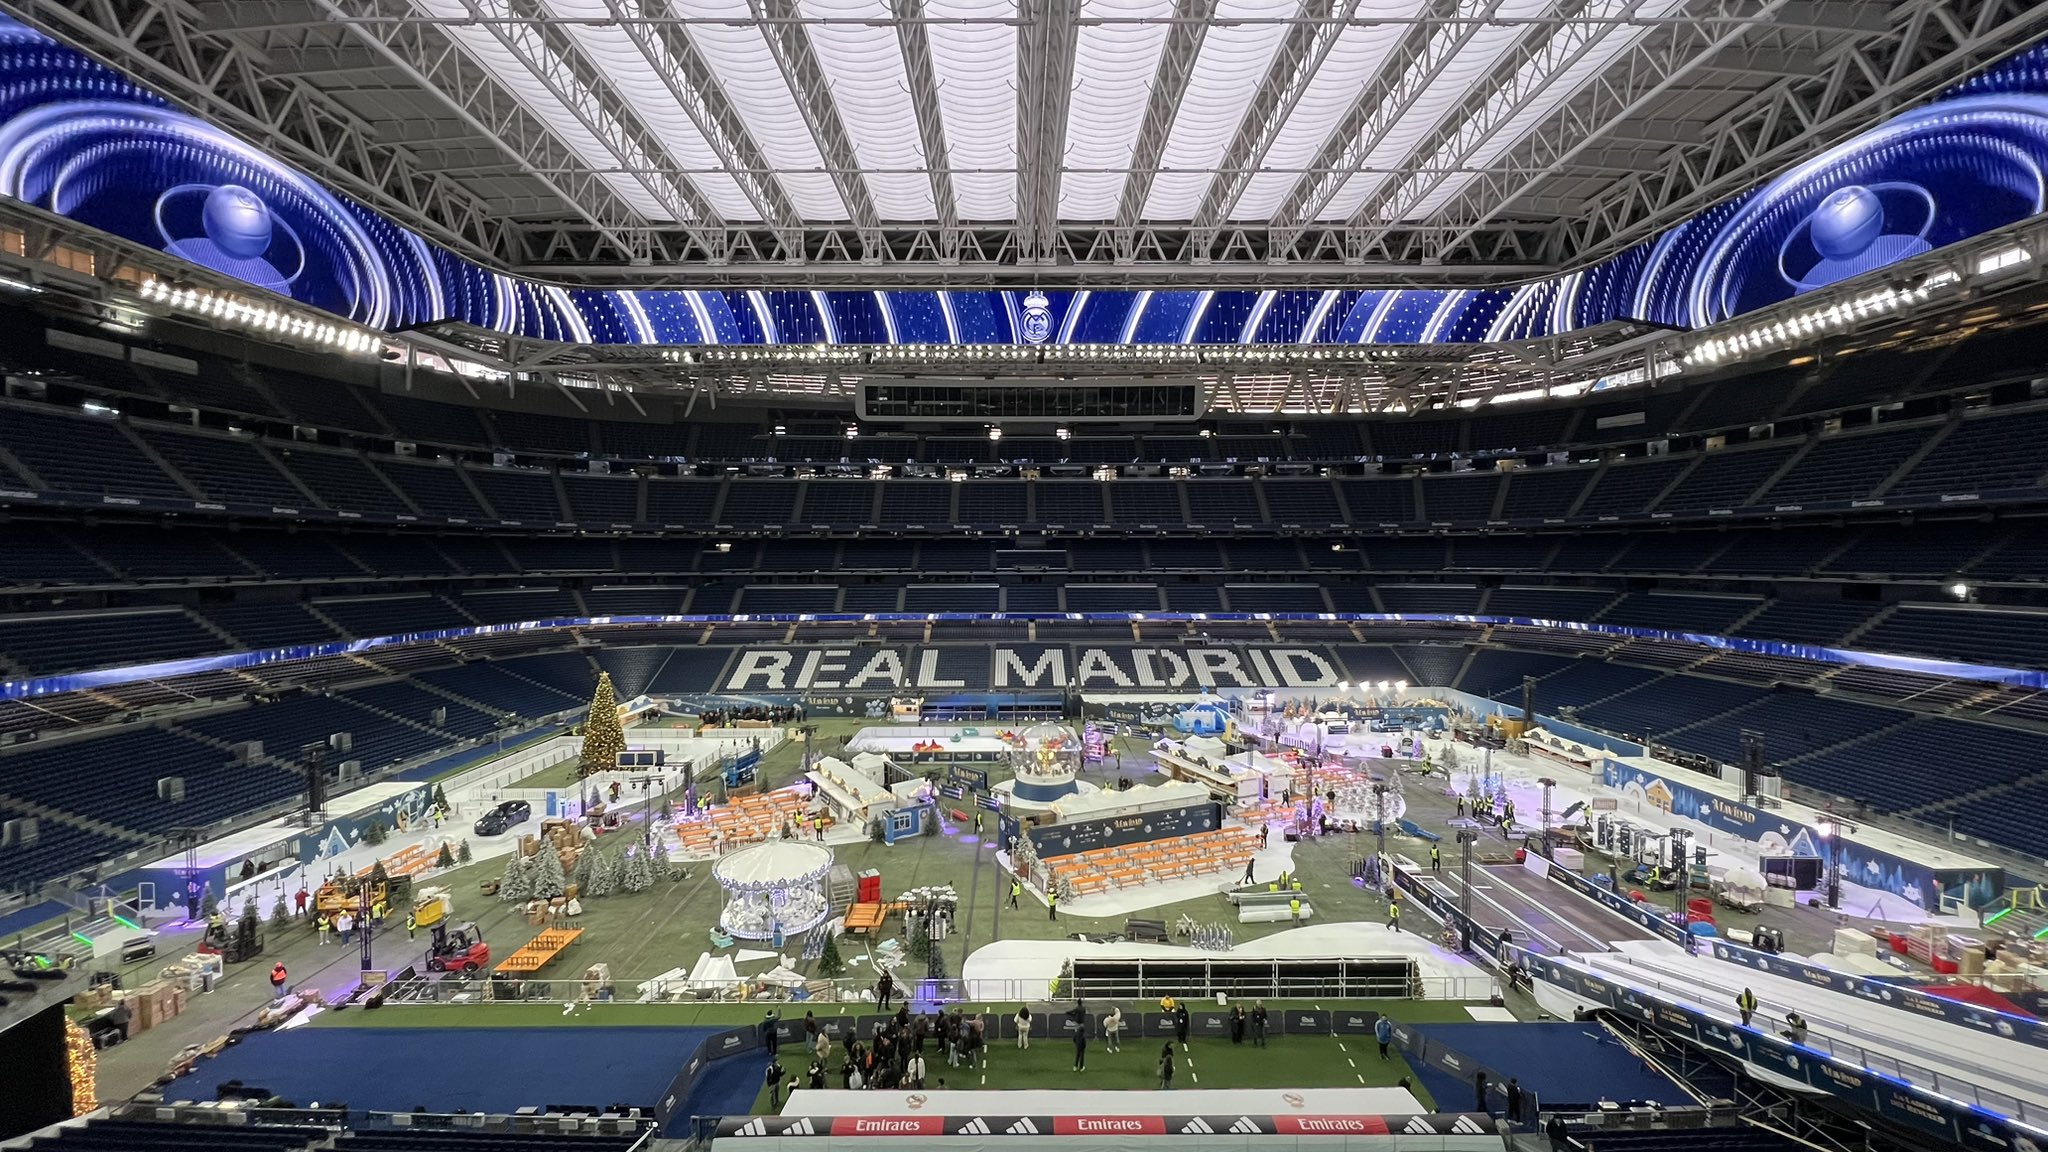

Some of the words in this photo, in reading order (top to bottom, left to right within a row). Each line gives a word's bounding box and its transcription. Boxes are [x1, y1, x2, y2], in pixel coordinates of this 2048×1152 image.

[726, 649, 965, 689] REAL
[994, 648, 1340, 689] MADRID
[855, 1119, 920, 1131] Emirates
[1077, 1118, 1142, 1131] Emirates
[1298, 1117, 1364, 1131] Emirates
